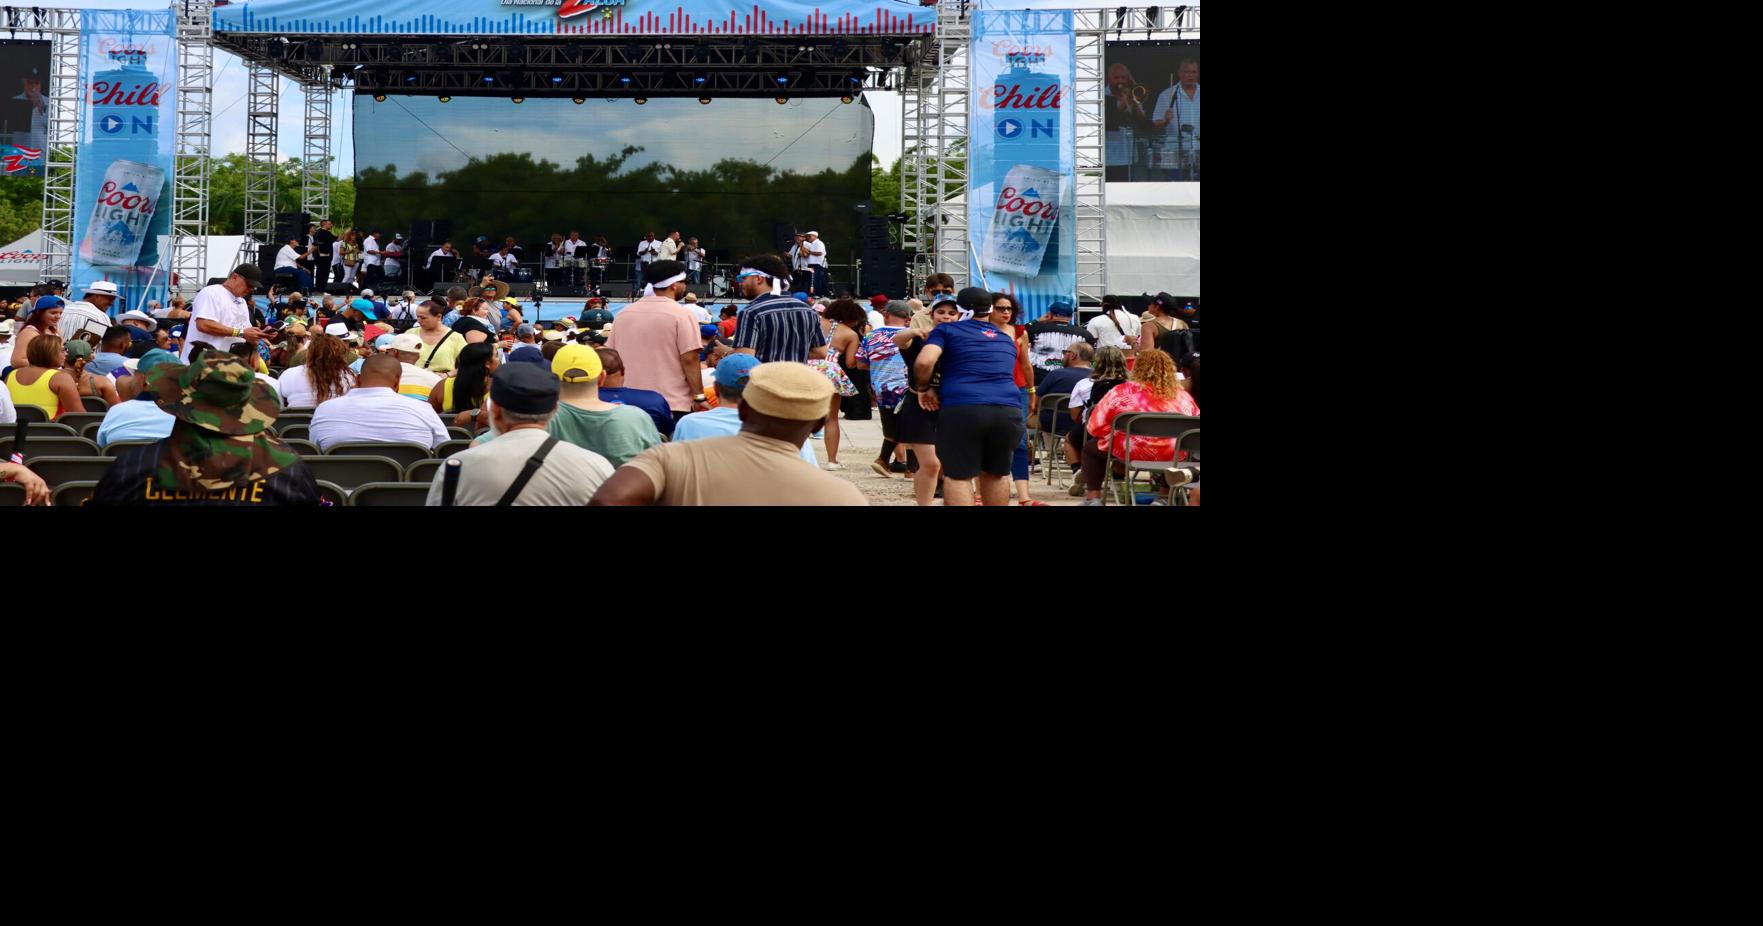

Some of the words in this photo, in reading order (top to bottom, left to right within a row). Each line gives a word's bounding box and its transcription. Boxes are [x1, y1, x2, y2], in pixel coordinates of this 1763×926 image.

[84, 81, 171, 106] Chill
[979, 84, 1070, 109] Chill
[146, 478, 266, 502] CLNTE
